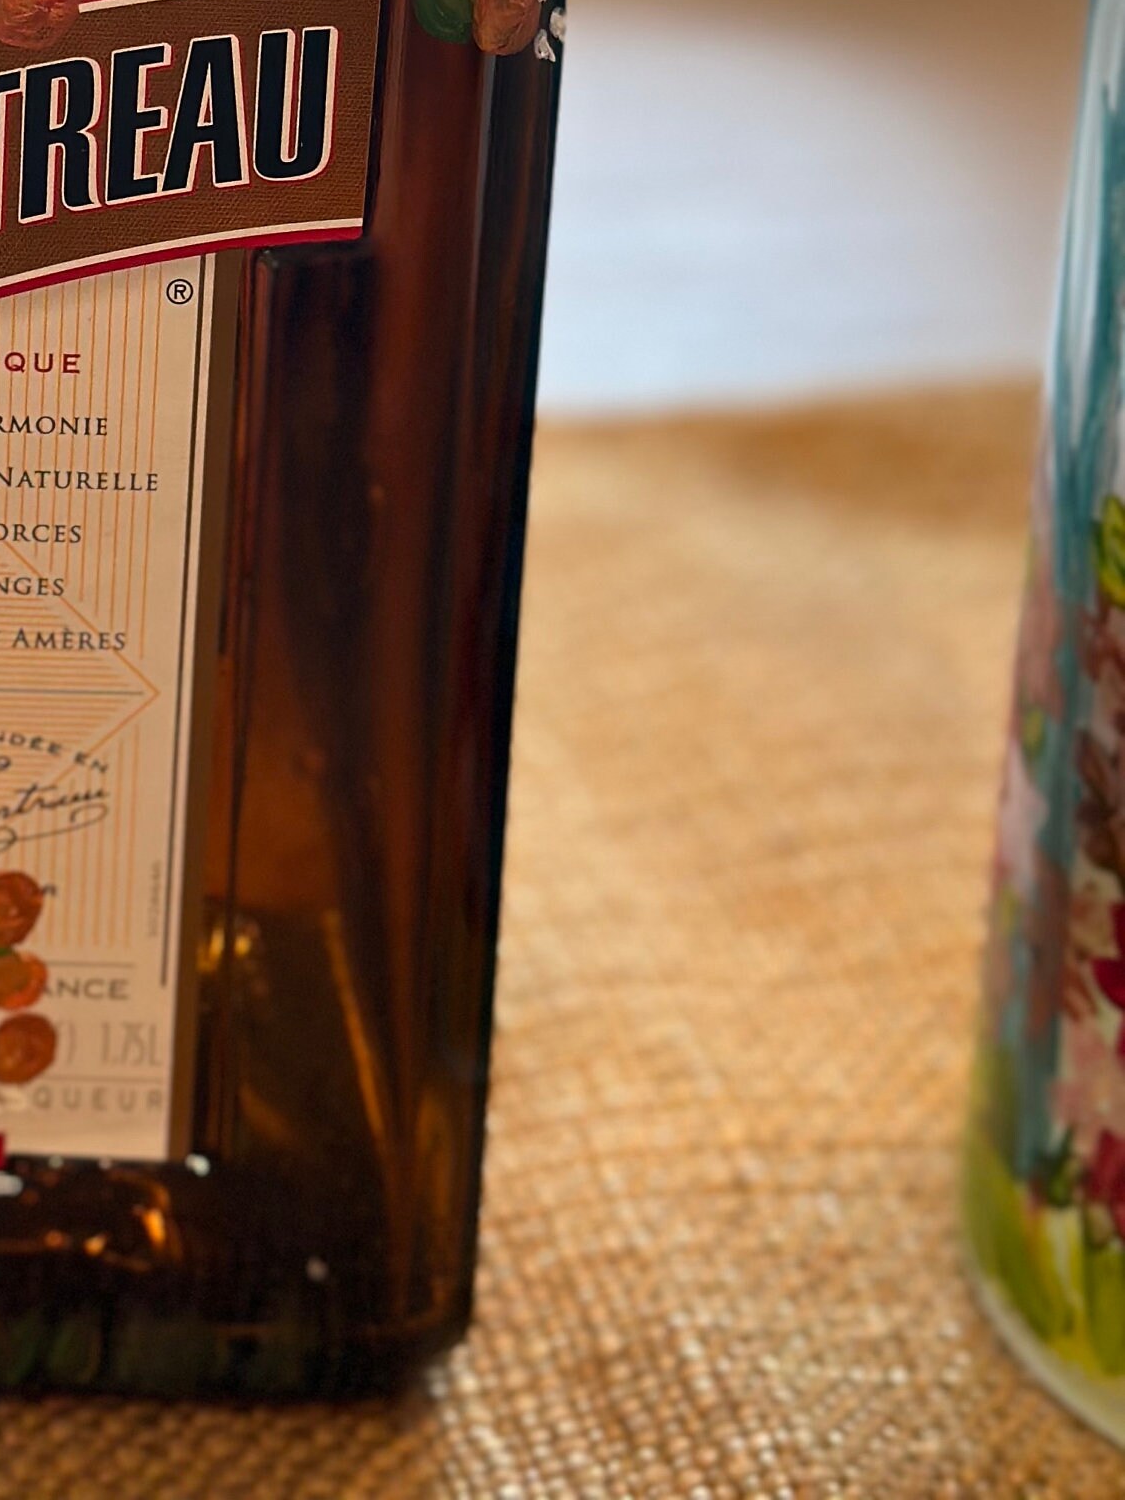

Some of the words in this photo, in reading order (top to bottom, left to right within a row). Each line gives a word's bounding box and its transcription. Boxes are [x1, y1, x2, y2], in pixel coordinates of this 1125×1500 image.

[11, 626, 127, 651] AMÈRES
[74, 751, 110, 774] EN
[36, 1085, 164, 1113] QUEUR
